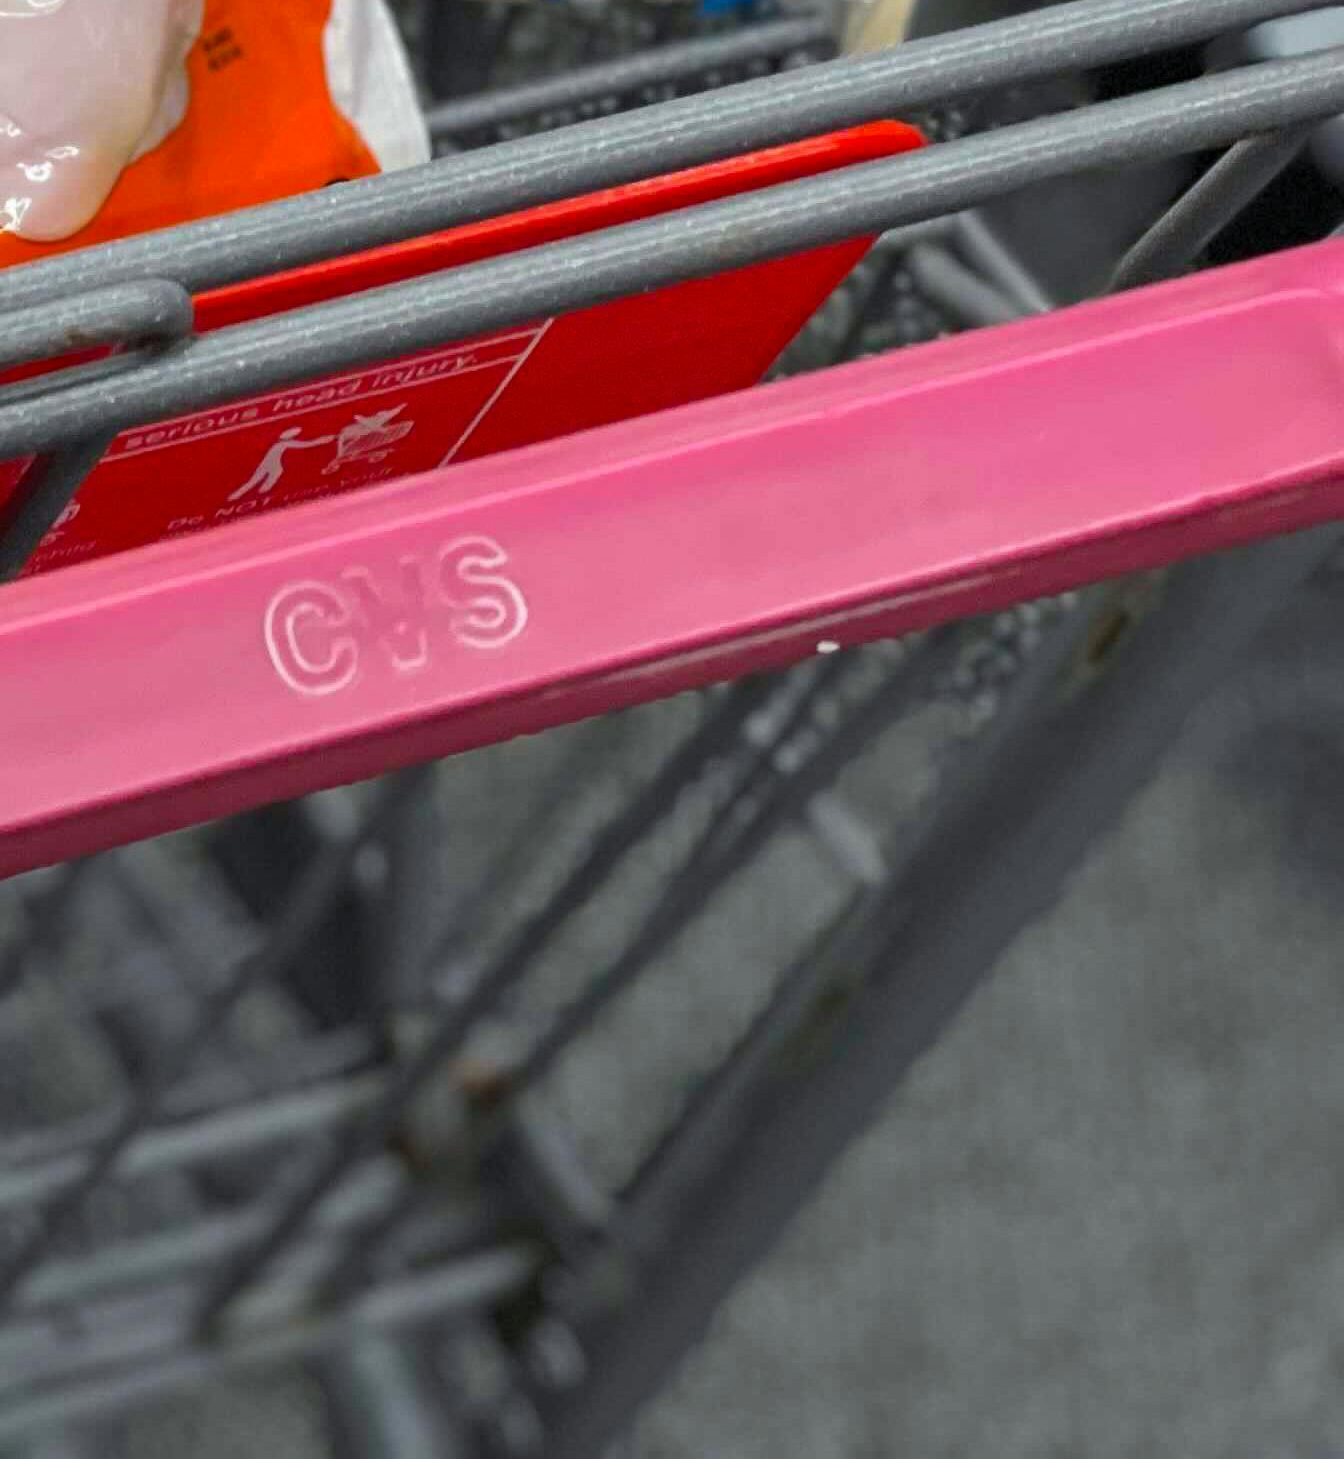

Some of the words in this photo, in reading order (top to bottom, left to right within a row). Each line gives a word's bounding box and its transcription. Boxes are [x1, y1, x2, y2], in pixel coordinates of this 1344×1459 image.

[124, 407, 258, 451] serious
[272, 377, 362, 414] head
[372, 353, 479, 393] injury.
[264, 535, 528, 697] CVS
